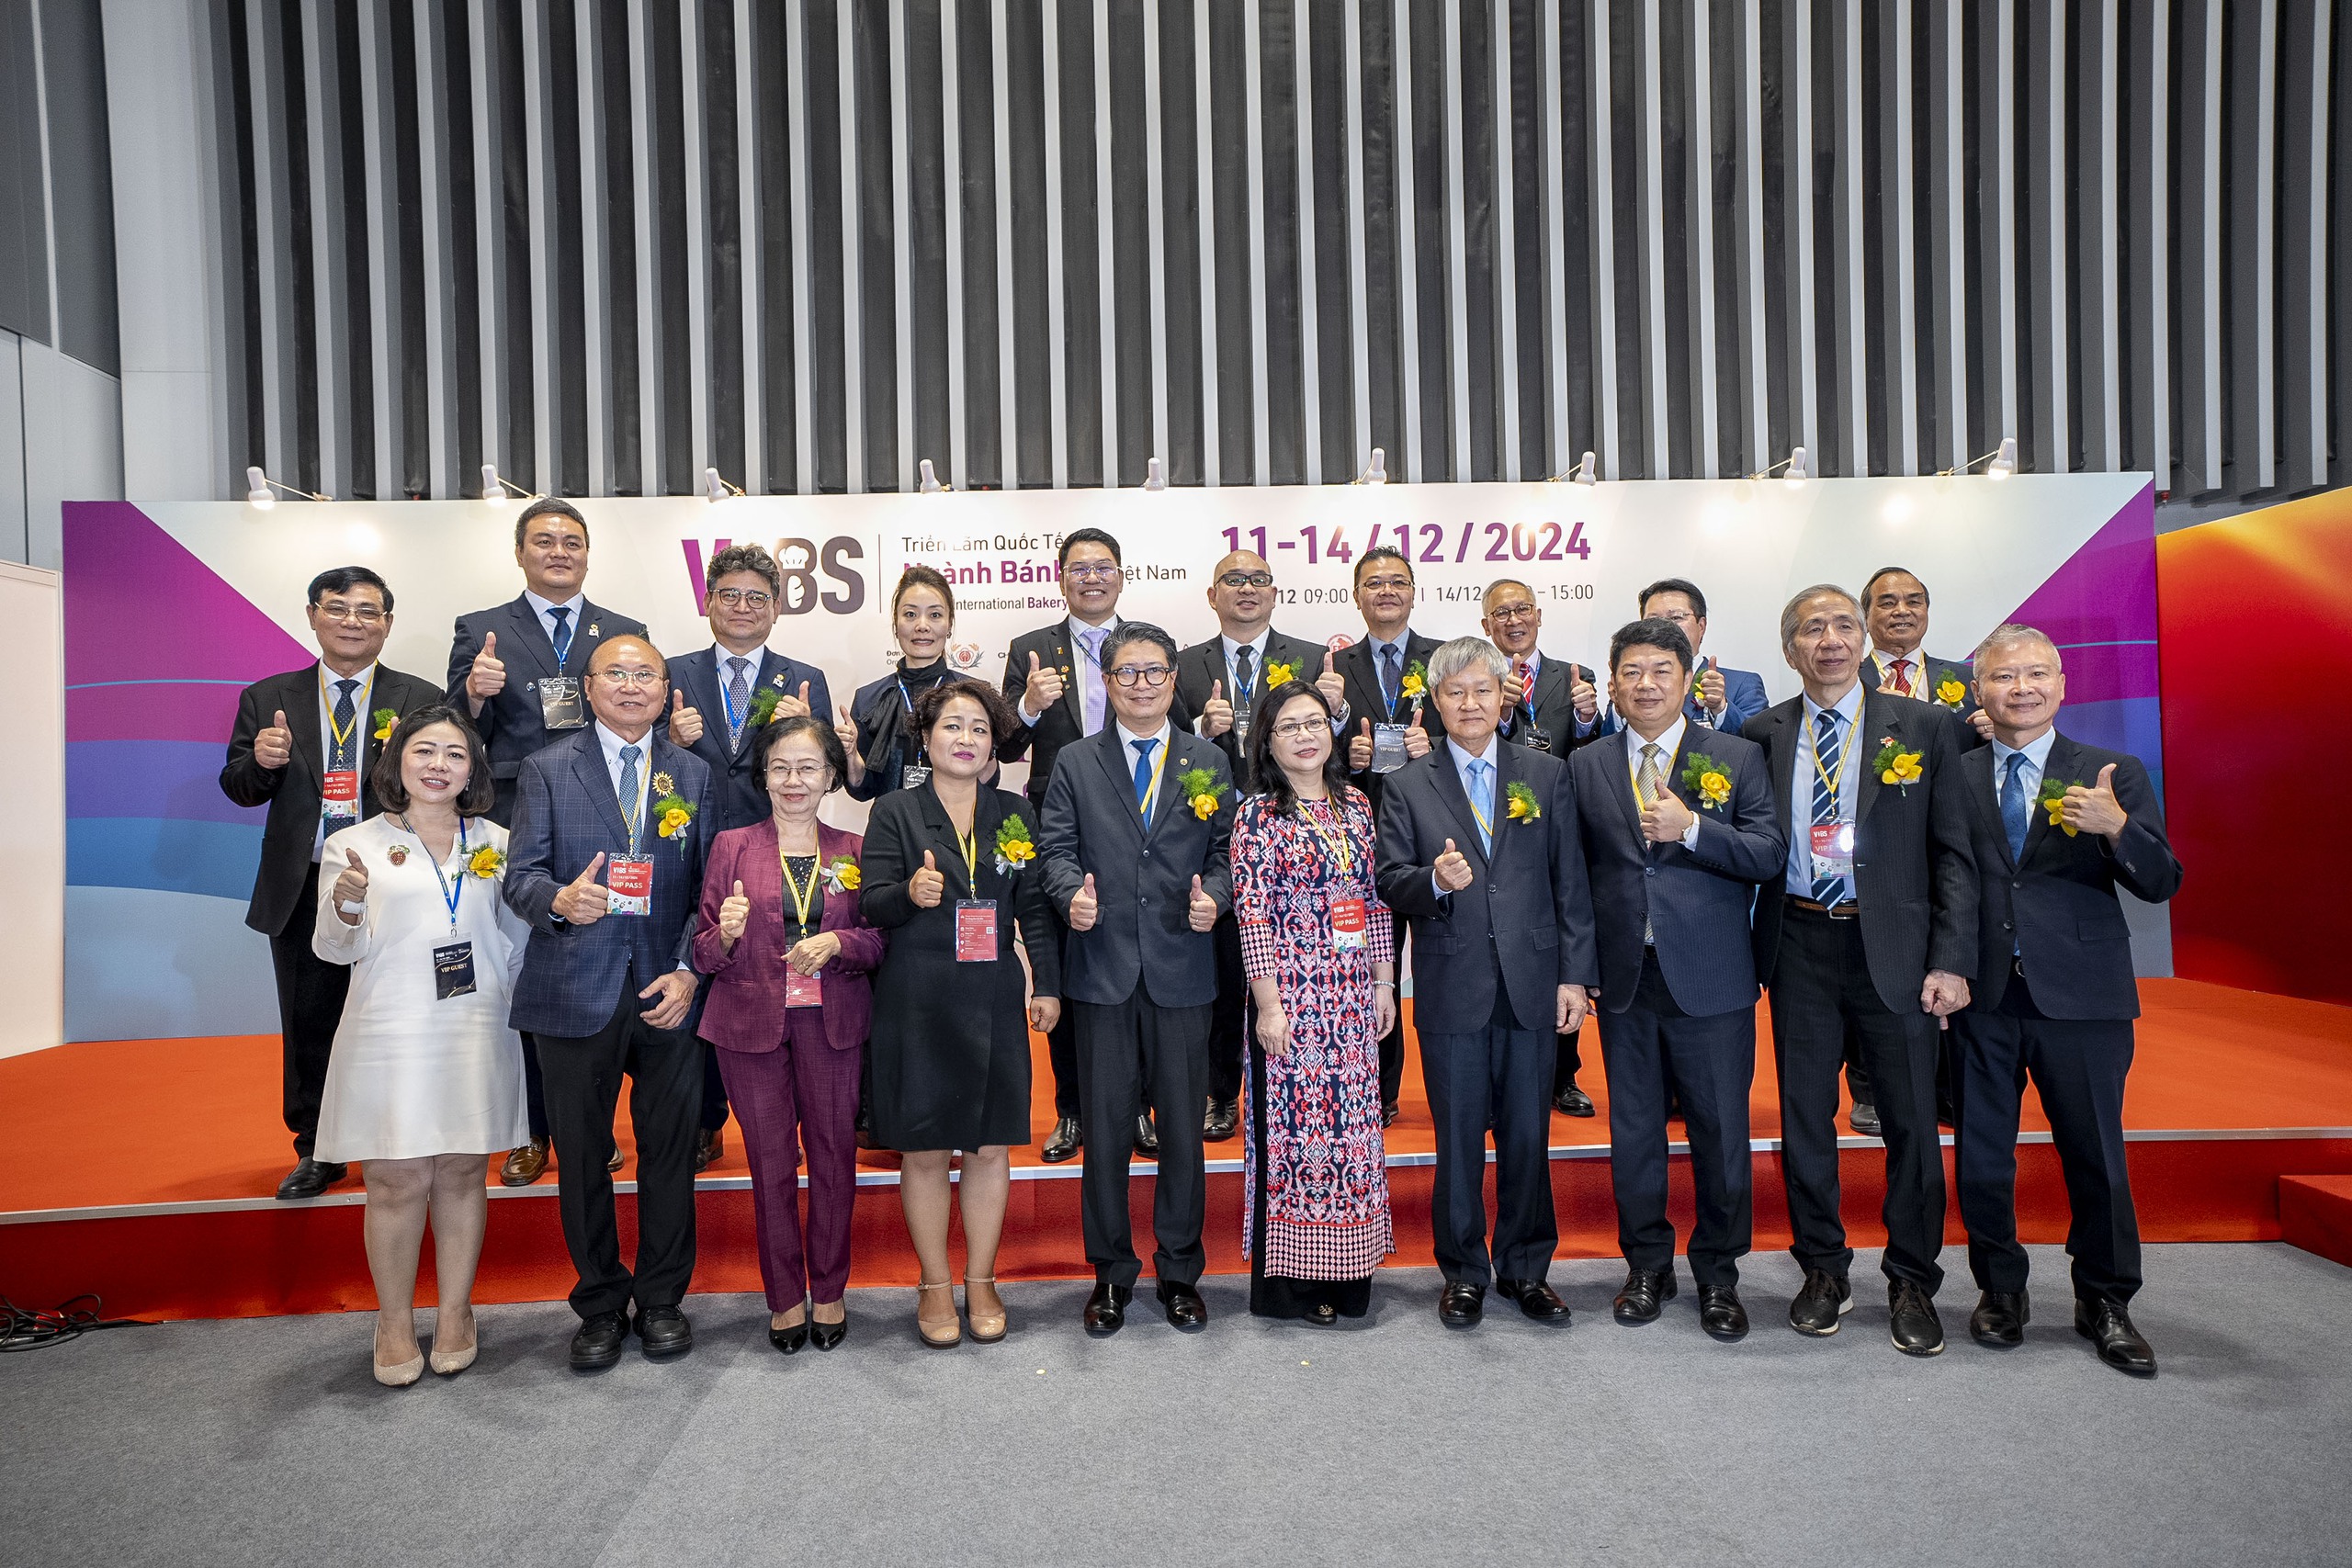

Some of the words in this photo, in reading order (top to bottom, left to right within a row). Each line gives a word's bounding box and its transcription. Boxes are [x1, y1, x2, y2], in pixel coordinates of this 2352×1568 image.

[994, 533, 1039, 551] Quốc
[1043, 532, 1063, 549] Tế
[1221, 525, 1352, 564] 11-14
[1393, 524, 1444, 562] 12
[1484, 522, 1591, 561] 2024
[681, 536, 865, 615] VBS
[1147, 565, 1187, 580] Nam
[1304, 588, 1349, 604] 09:00
[1436, 586, 1482, 602] 14/12
[1551, 584, 1594, 600] 15:00
[953, 597, 1024, 610] nternational
[1027, 596, 1068, 611] Bakery
[1345, 918, 1360, 926] PASS
[450, 963, 468, 971] GUEST
